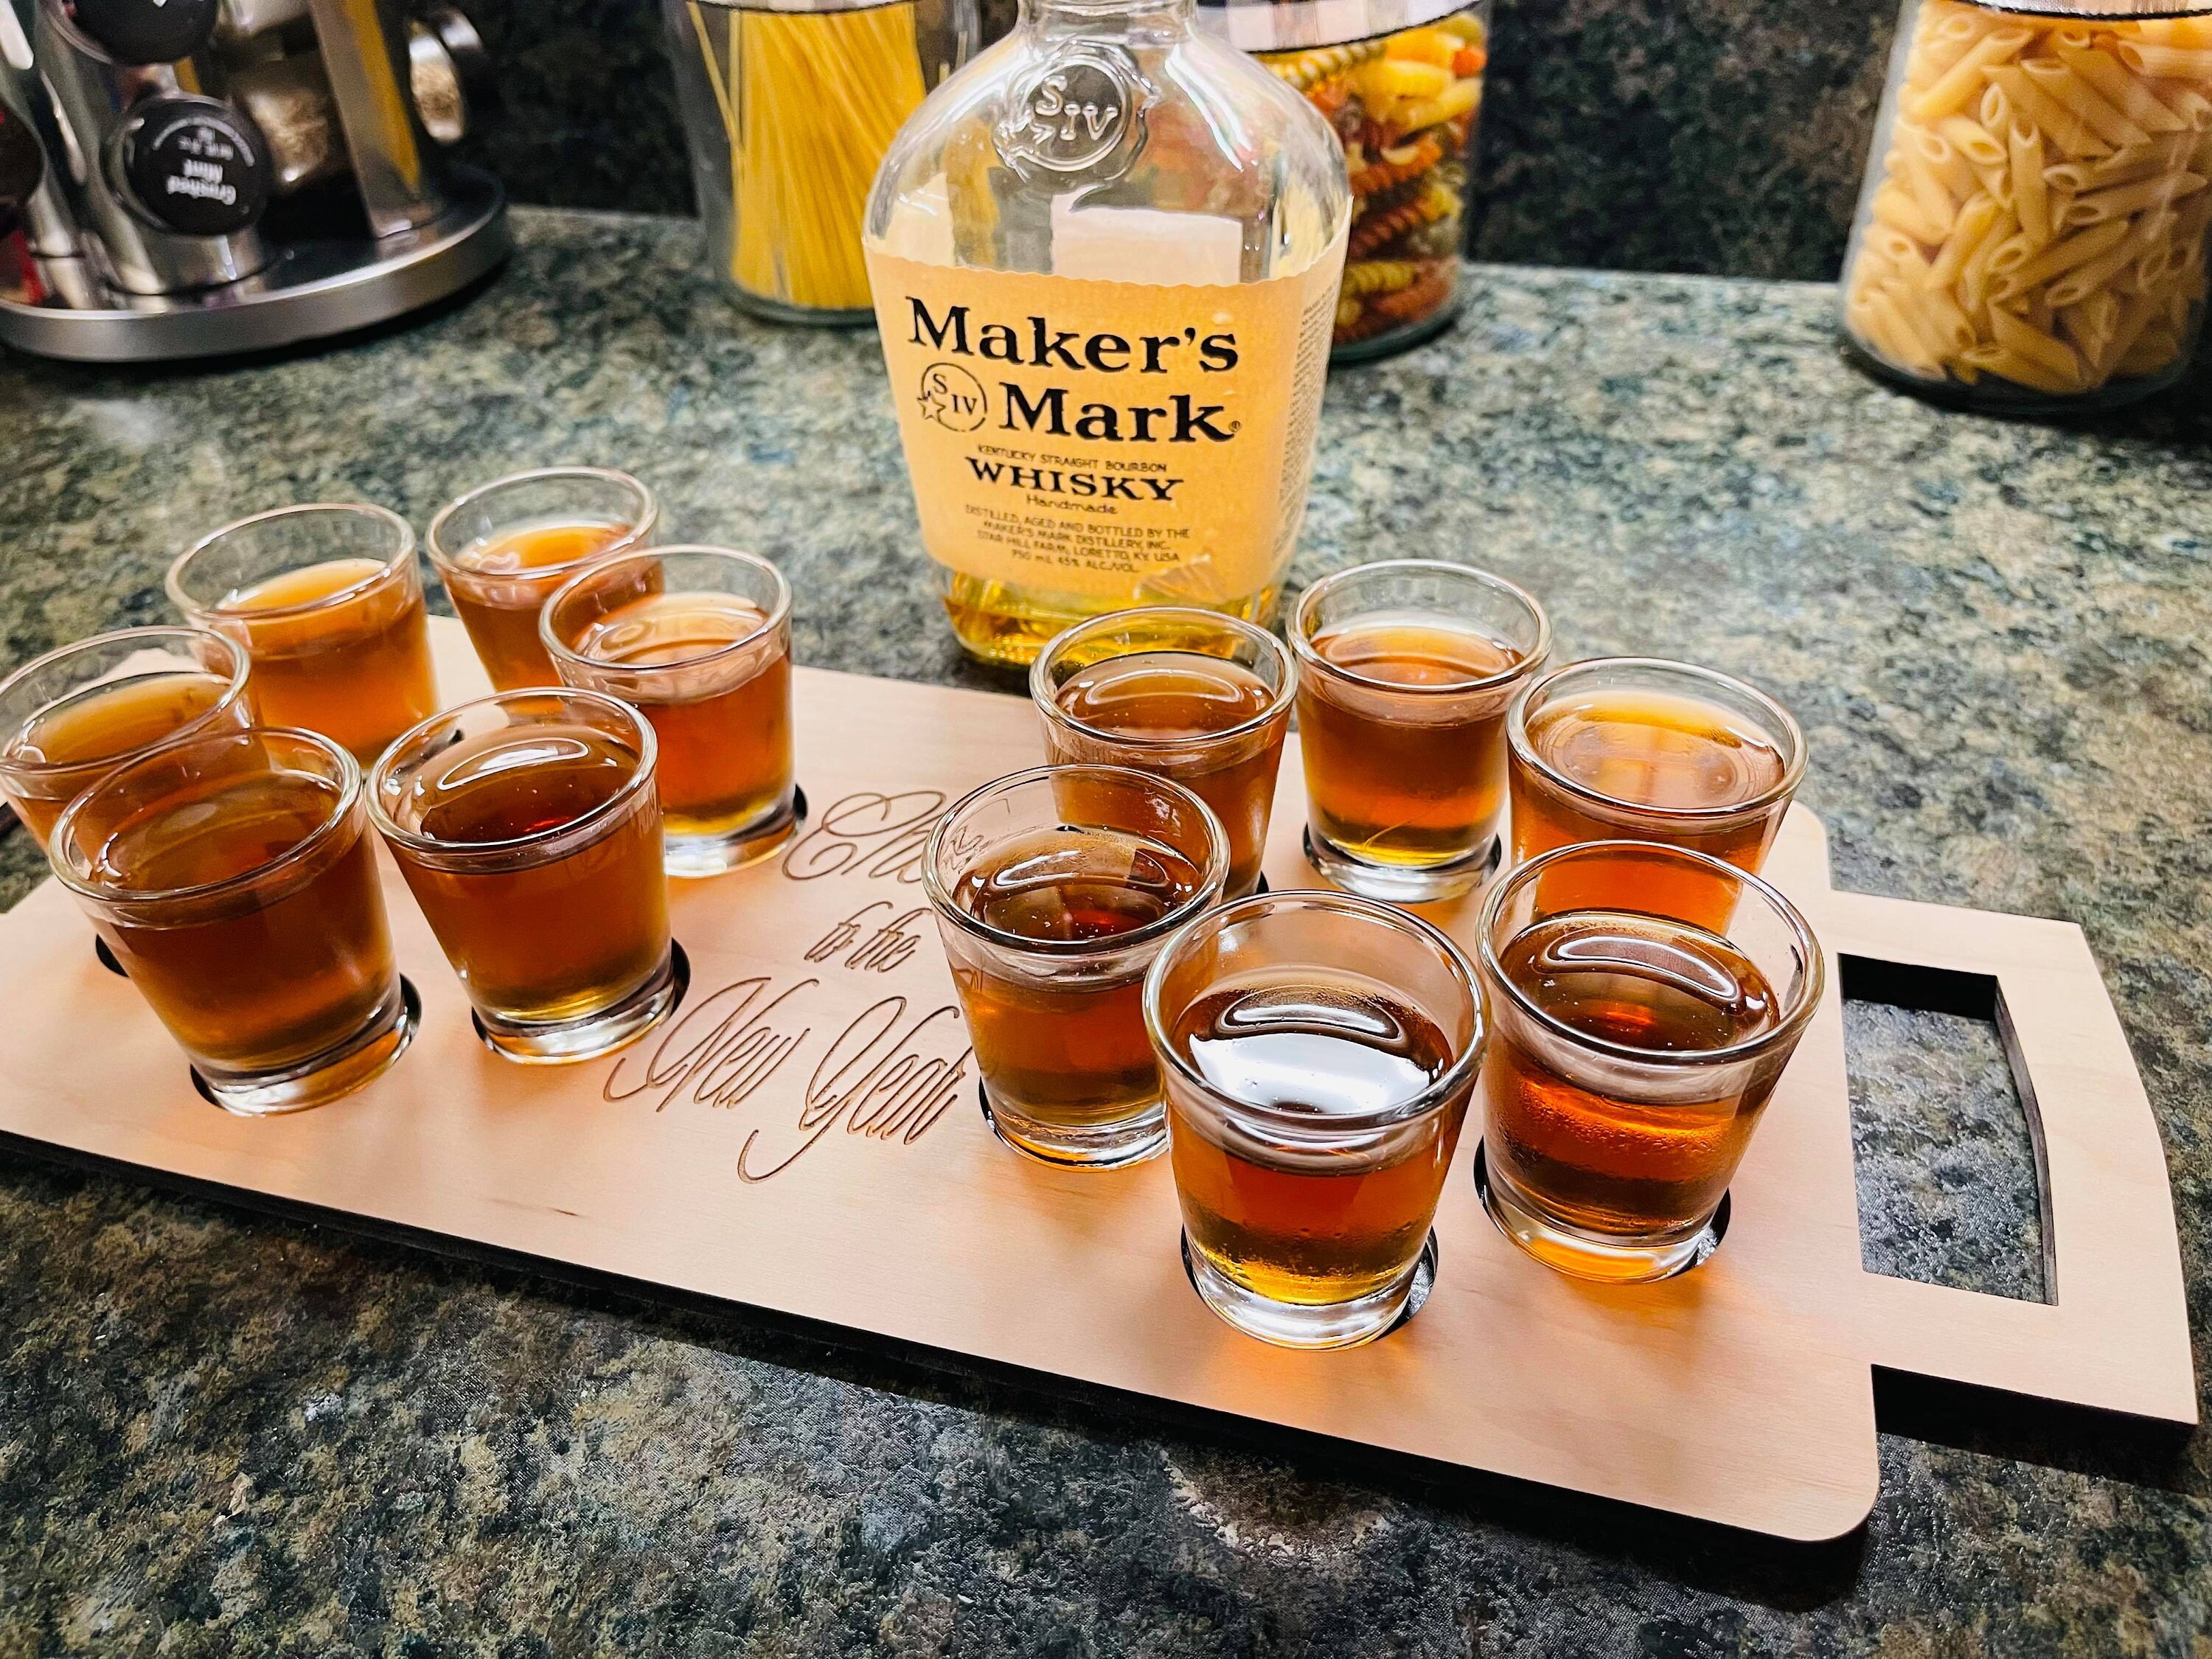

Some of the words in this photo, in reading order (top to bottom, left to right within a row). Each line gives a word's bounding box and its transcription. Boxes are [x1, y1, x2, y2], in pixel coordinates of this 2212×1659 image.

[905, 296, 1239, 373] Maker's
[998, 381, 1234, 442] Mark
[978, 444, 1035, 462] KENTUCKY
[1040, 453, 1098, 470] STRAIGHT
[1105, 460, 1166, 473] BOURBON
[965, 456, 1183, 501] WHISKY
[1026, 494, 1118, 515] Handmade
[1025, 517, 1056, 529] AGED
[1060, 521, 1084, 532] AND
[1088, 524, 1142, 538] BOTTLED
[1147, 528, 1162, 538] BY
[1166, 529, 1190, 539] THE
[1038, 530, 1071, 542] MARK
[1154, 552, 1180, 562] USA
[602, 976, 820, 1113] New
[737, 995, 973, 1185] Year
